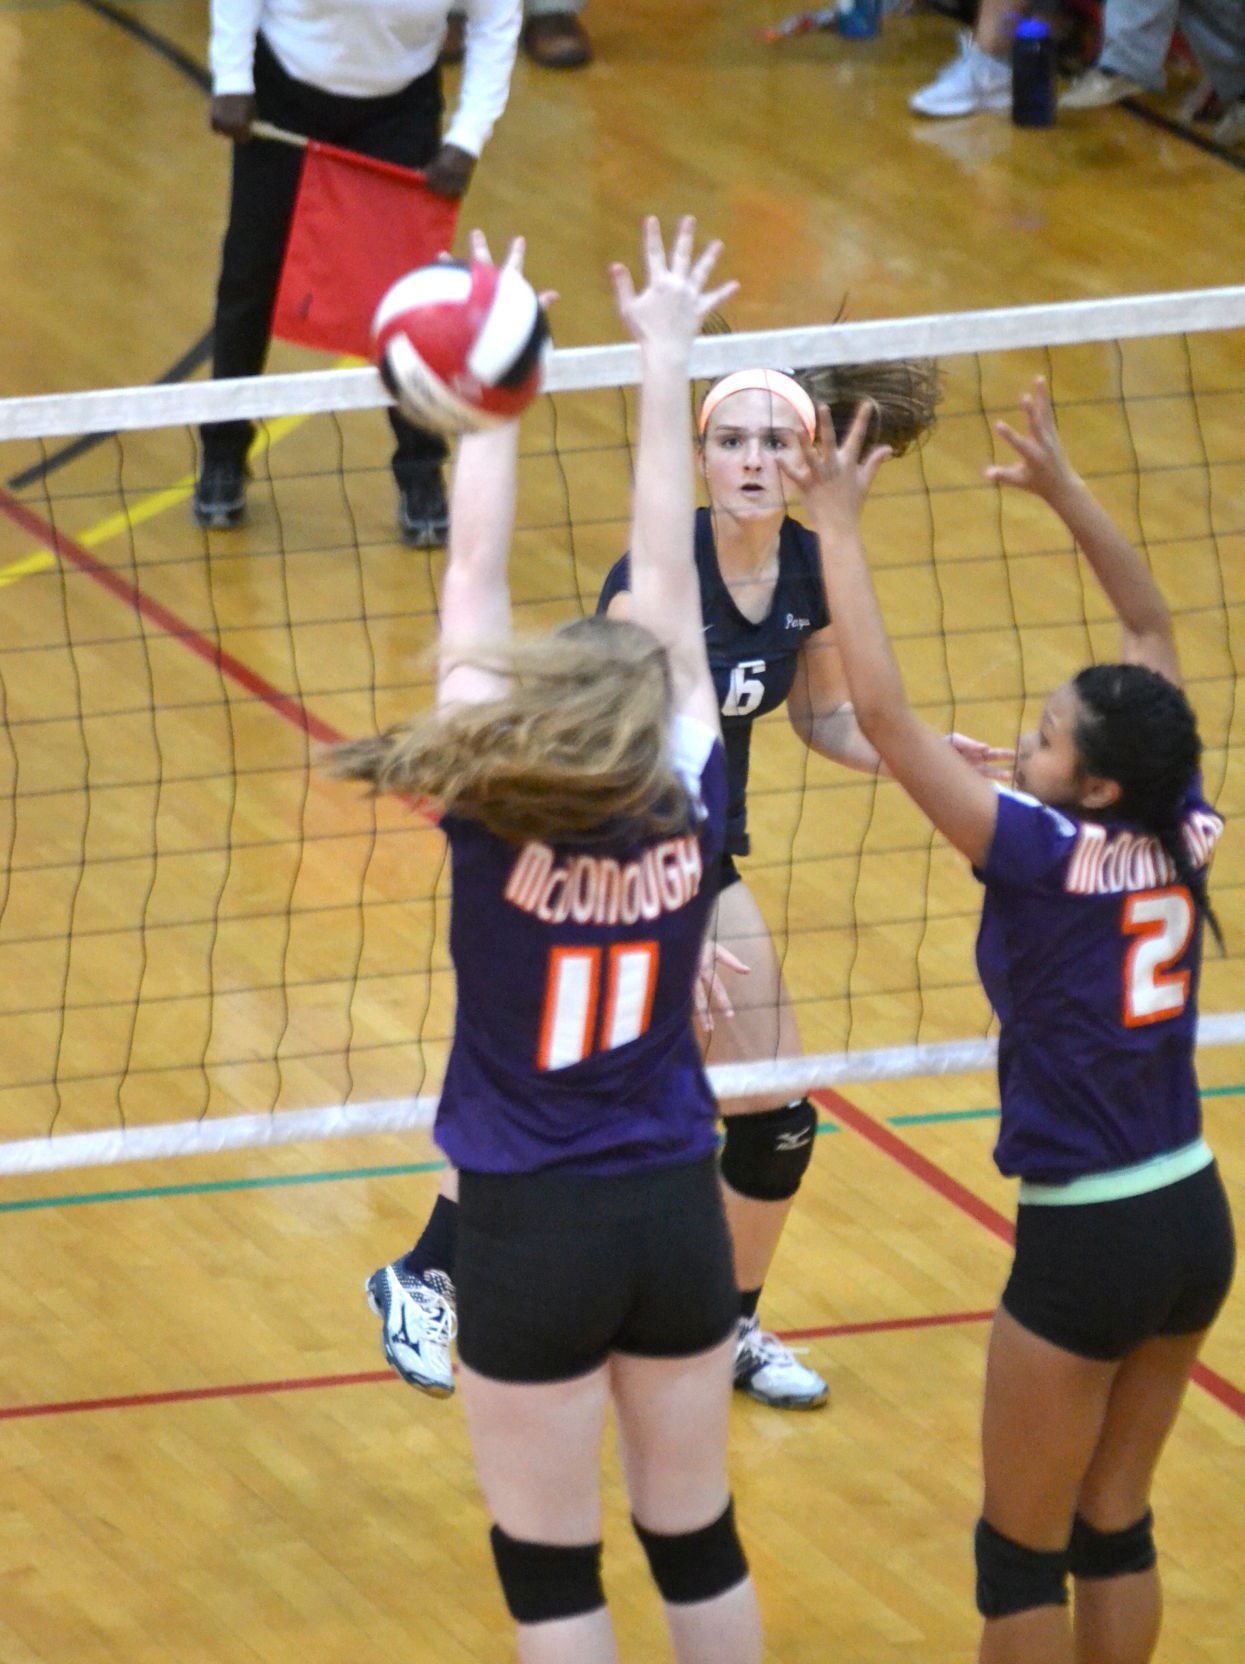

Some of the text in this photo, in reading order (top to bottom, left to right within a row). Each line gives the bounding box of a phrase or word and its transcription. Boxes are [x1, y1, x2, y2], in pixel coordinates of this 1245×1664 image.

[721, 659, 767, 717] 6
[536, 940, 660, 1073] 11
[1121, 884, 1195, 1028] 2
